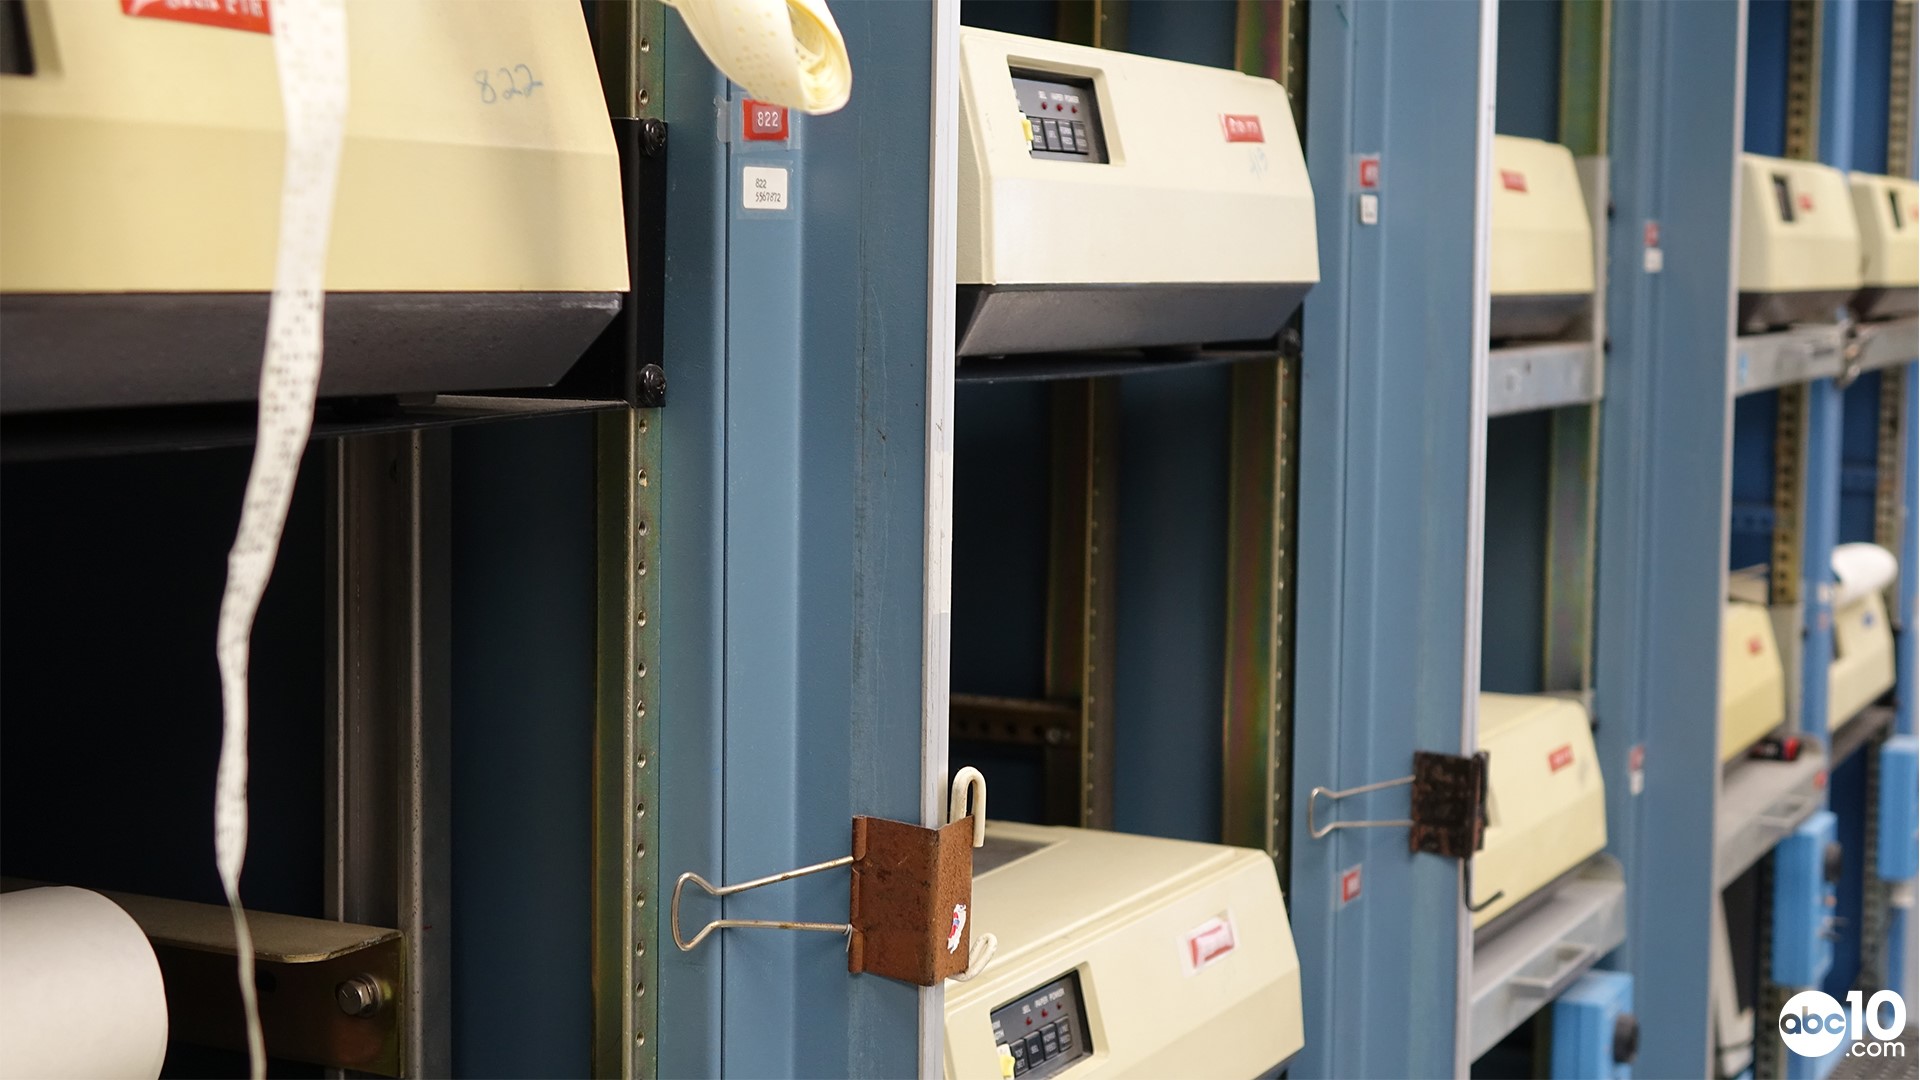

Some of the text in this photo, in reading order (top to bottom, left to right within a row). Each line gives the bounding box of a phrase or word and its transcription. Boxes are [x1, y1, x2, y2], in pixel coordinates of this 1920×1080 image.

[474, 63, 544, 104] 822
[757, 111, 779, 127] 822
[755, 178, 767, 189] 822
